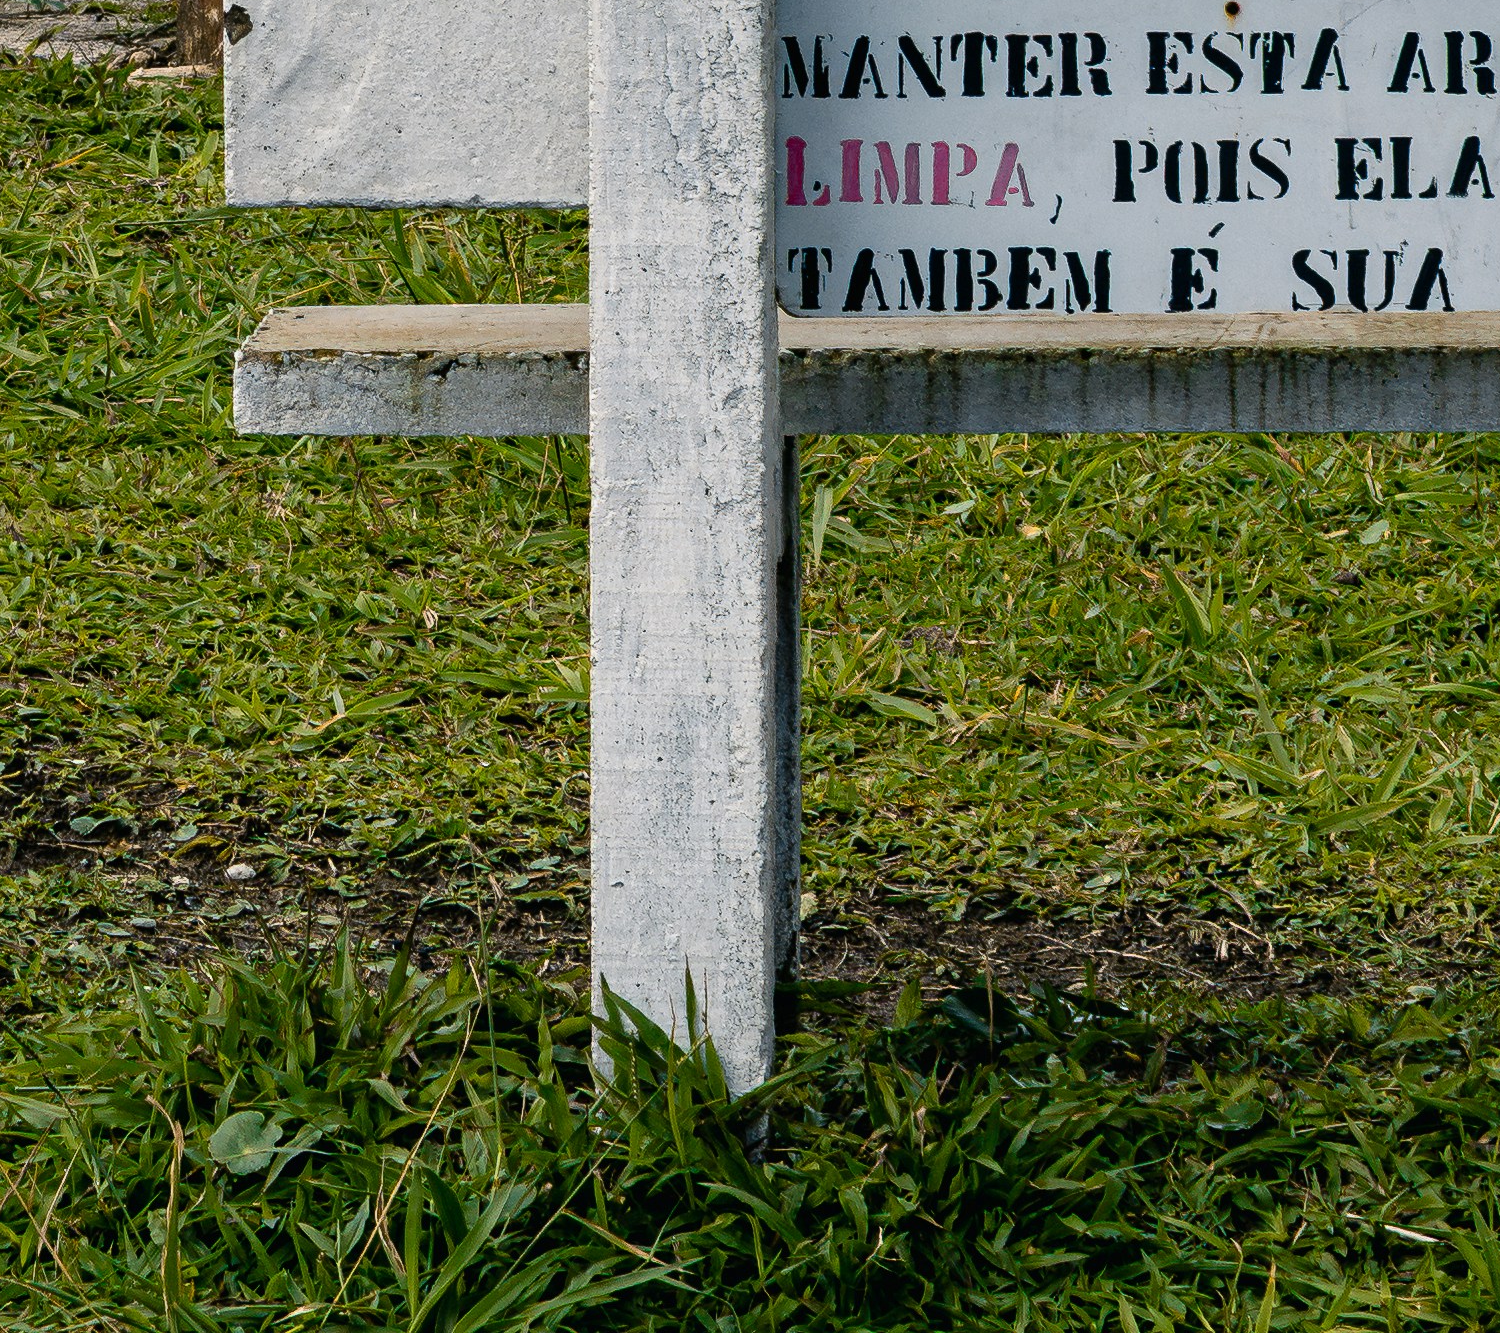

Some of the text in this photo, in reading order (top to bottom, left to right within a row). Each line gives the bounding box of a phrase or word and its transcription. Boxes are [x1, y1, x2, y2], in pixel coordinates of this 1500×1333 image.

[780, 32, 1114, 100] MANTER
[1145, 27, 1350, 96] ESTA
[785, 135, 1496, 225] LIMPA, POIS ELA
[788, 221, 1456, 314] TAMBEM É SUA
